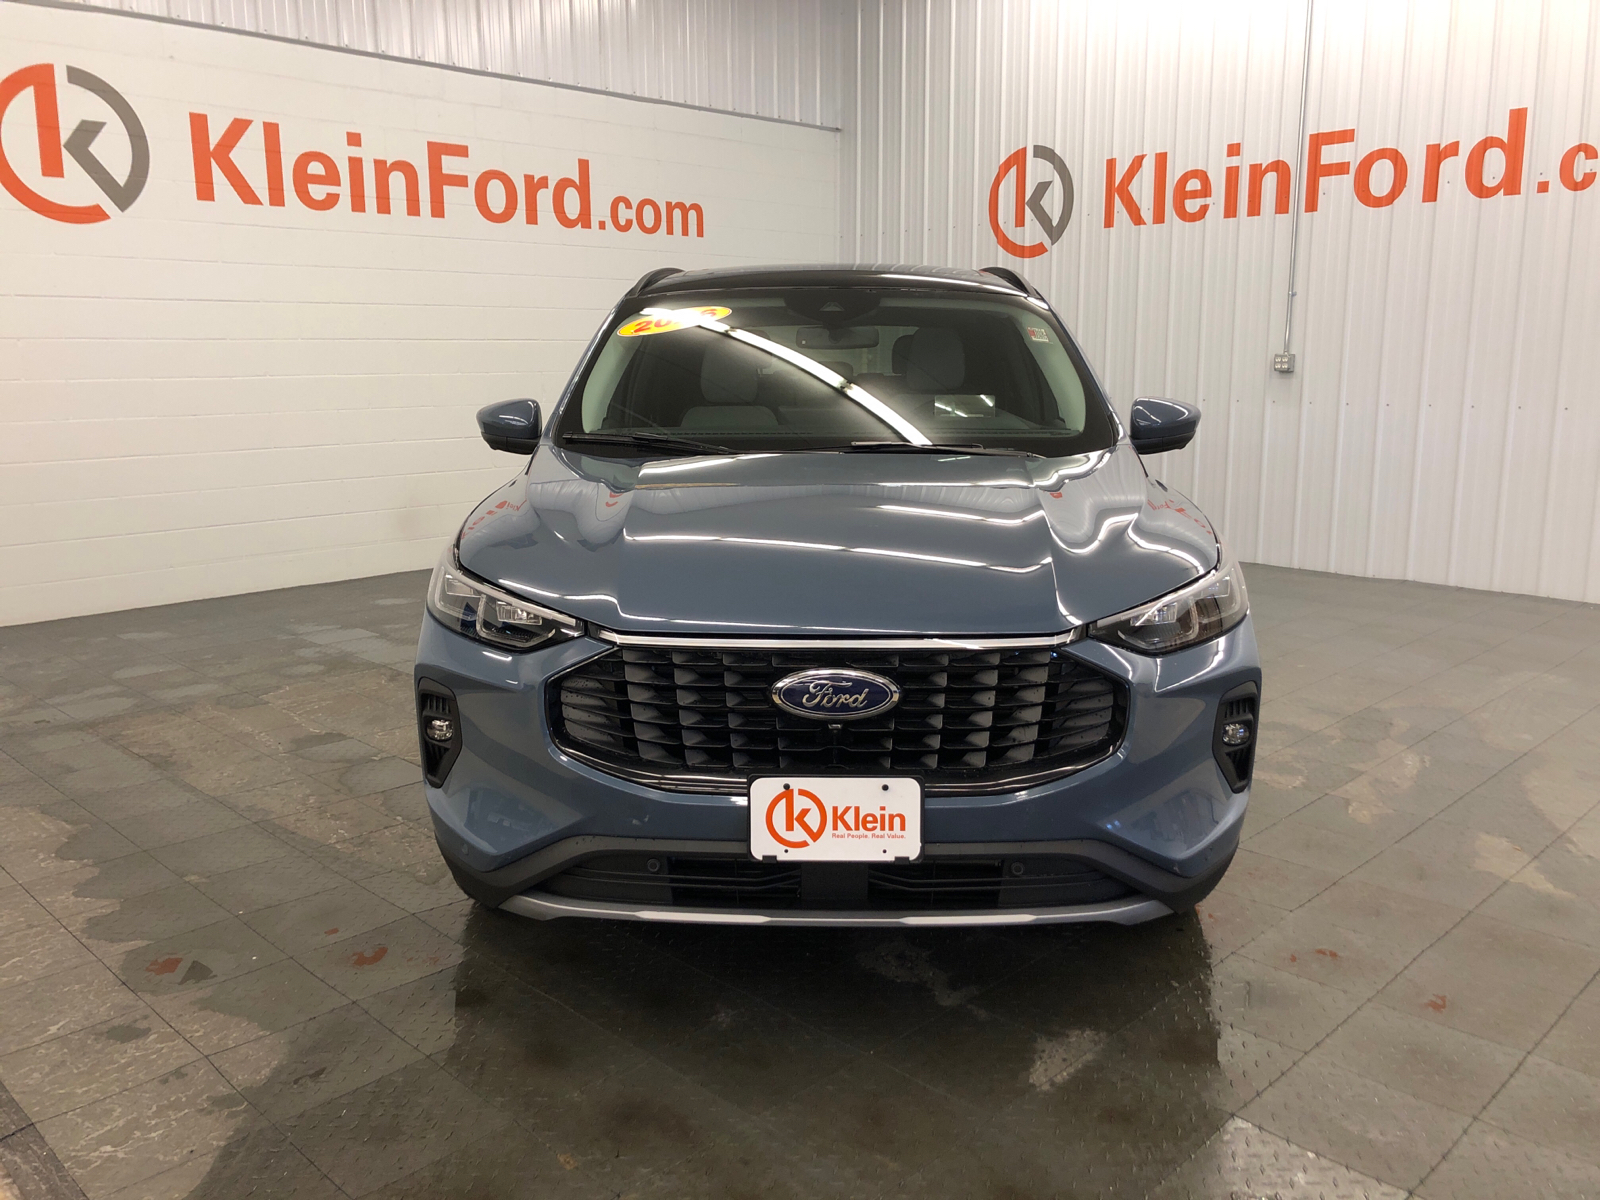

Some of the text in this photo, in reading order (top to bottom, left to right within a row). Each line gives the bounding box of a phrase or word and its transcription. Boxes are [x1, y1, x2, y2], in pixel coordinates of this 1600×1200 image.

[189, 112, 705, 237] KleinFord.com
[802, 680, 869, 708] Ford
[832, 806, 906, 832] Klein
[846, 832, 869, 841] People.
